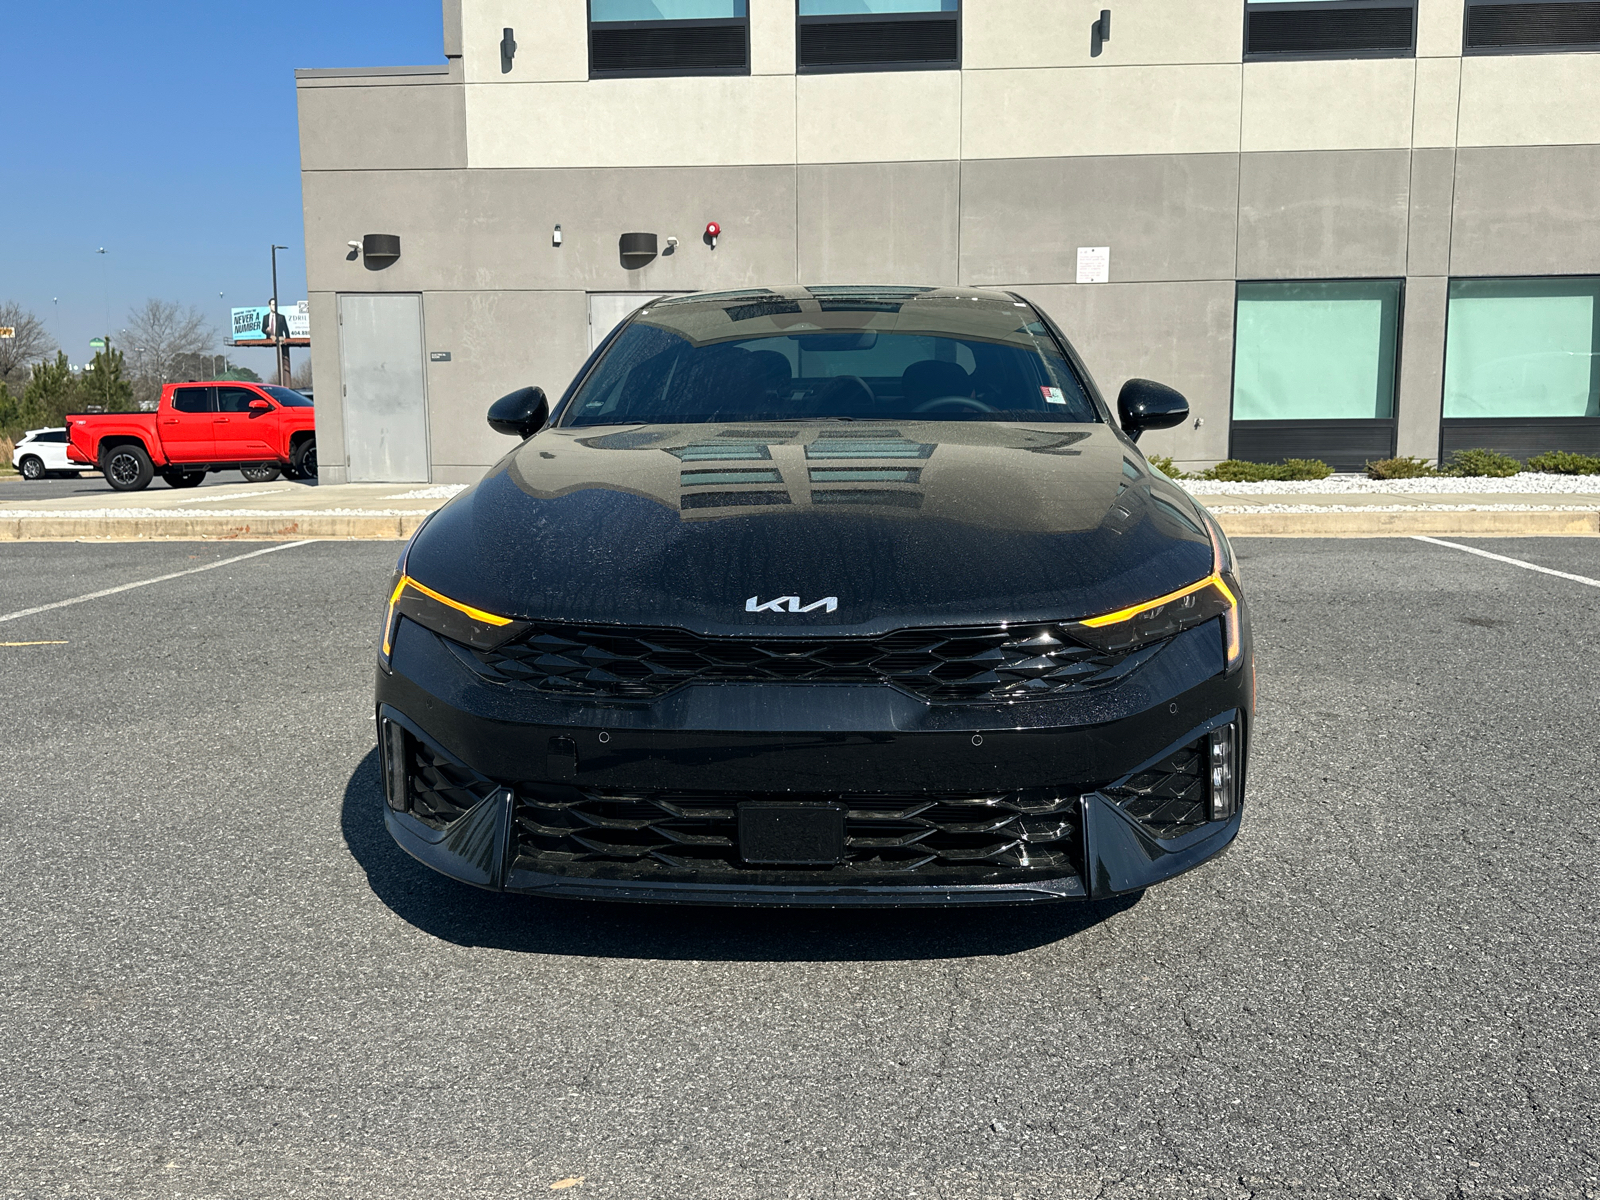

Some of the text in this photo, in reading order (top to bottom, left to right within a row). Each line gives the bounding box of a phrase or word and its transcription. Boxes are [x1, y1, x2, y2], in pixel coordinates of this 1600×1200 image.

[234, 314, 254, 326] NEVER
[255, 312, 260, 321] A
[234, 320, 261, 334] NUMBER
[746, 596, 838, 612] KIA
